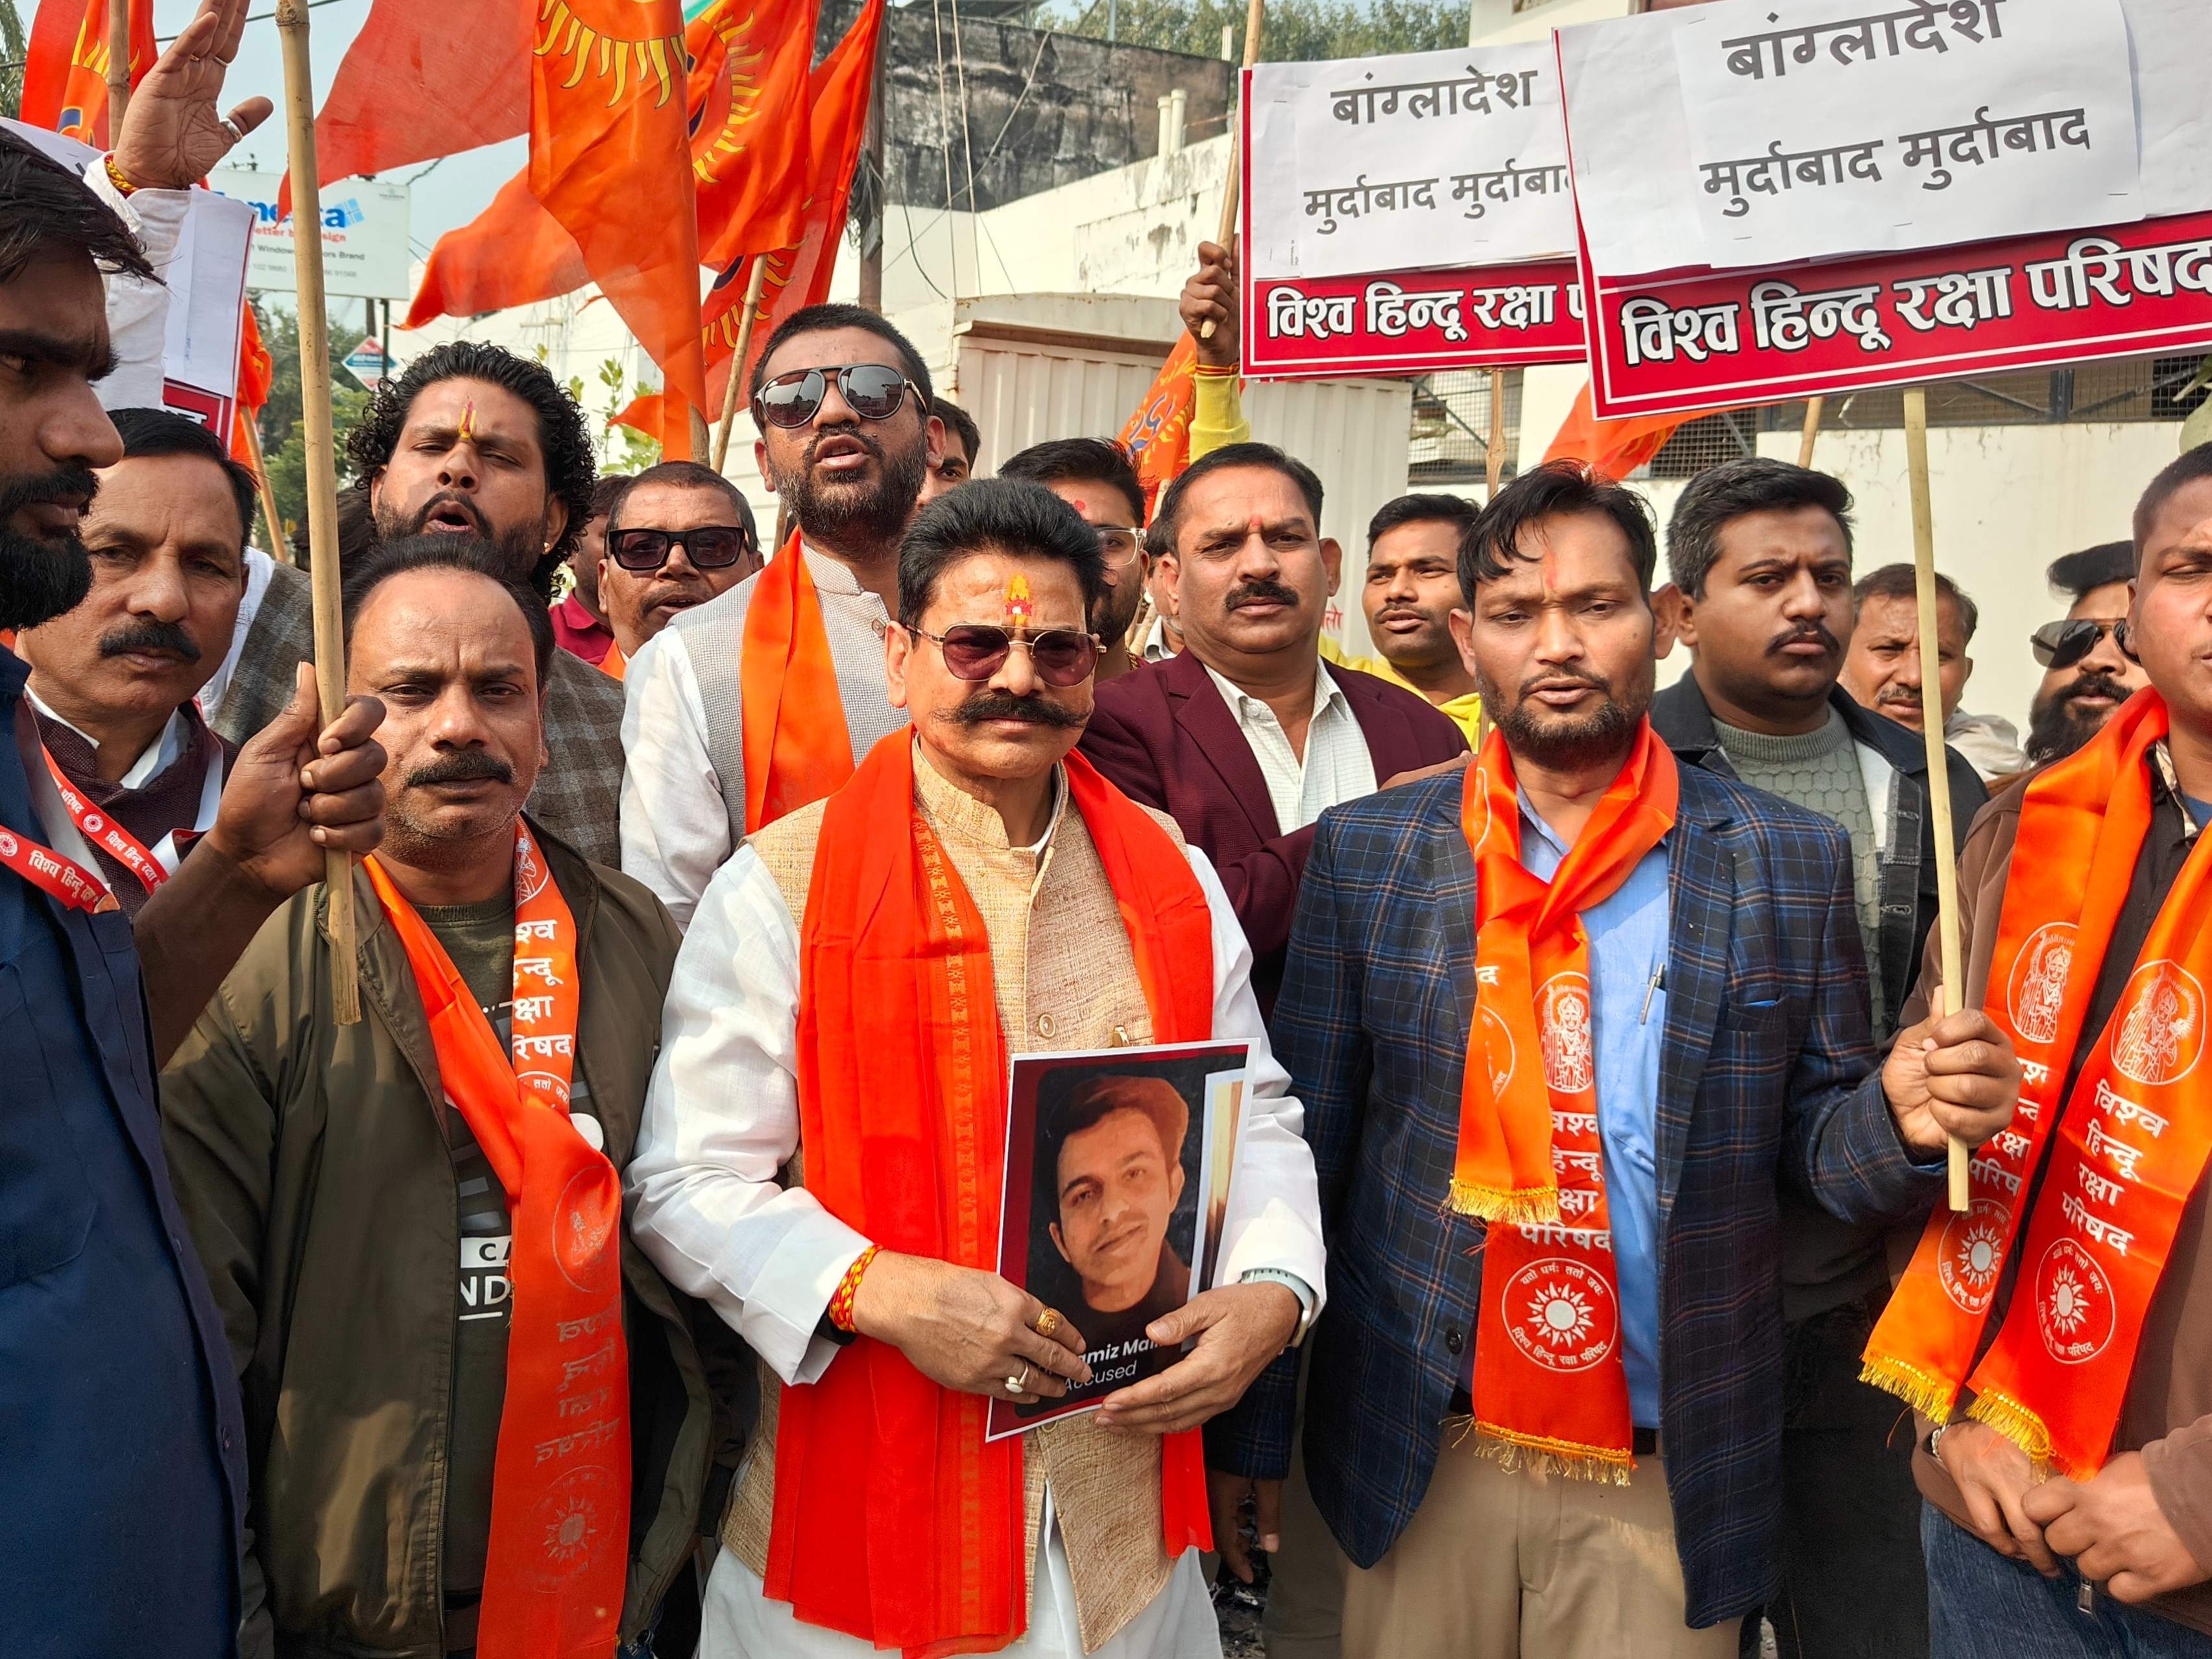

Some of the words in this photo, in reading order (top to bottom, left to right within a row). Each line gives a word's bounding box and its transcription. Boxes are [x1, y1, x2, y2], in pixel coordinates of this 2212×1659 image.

[1722, 0, 2006, 80] बांग्लादेश
[1330, 65, 1537, 125] बांग्लादेश
[1700, 141, 1883, 217] मुर्दाबाद
[1899, 106, 2090, 191] मुर्दाबाद
[1303, 175, 1439, 235] मुर्दाबाद
[254, 226, 285, 237] etter
[1268, 287, 1356, 339] विश्व
[1365, 281, 1467, 342] हिन्दू
[1472, 284, 1557, 329] रक्षा
[1622, 298, 1739, 366] विश्व
[1751, 279, 1891, 352] हिन्दू
[1892, 268, 2011, 331] रक्षा
[2023, 239, 2212, 308] परिषद
[514, 996, 555, 1024] क्षा
[2094, 1078, 2169, 1138] विश्व
[2086, 1117, 2144, 1182] हिन्दू
[1969, 1158, 2023, 1197] परिष
[2079, 1162, 2124, 1206] रक्षा
[1558, 1188, 1599, 1215] क्षा
[2062, 1191, 2134, 1256] परिषद
[1520, 1221, 1612, 1252] परिषद
[1520, 1269, 1538, 1285] यतो
[1565, 1265, 1585, 1280] ततो
[1587, 1276, 1604, 1296] जयः
[2089, 1270, 2103, 1294] जयः
[1511, 1326, 1532, 1349] विश्व
[1533, 1344, 1556, 1367] हिन्दू
[1558, 1355, 1578, 1365] रक्षा
[1065, 1359, 1137, 1390] Accused
